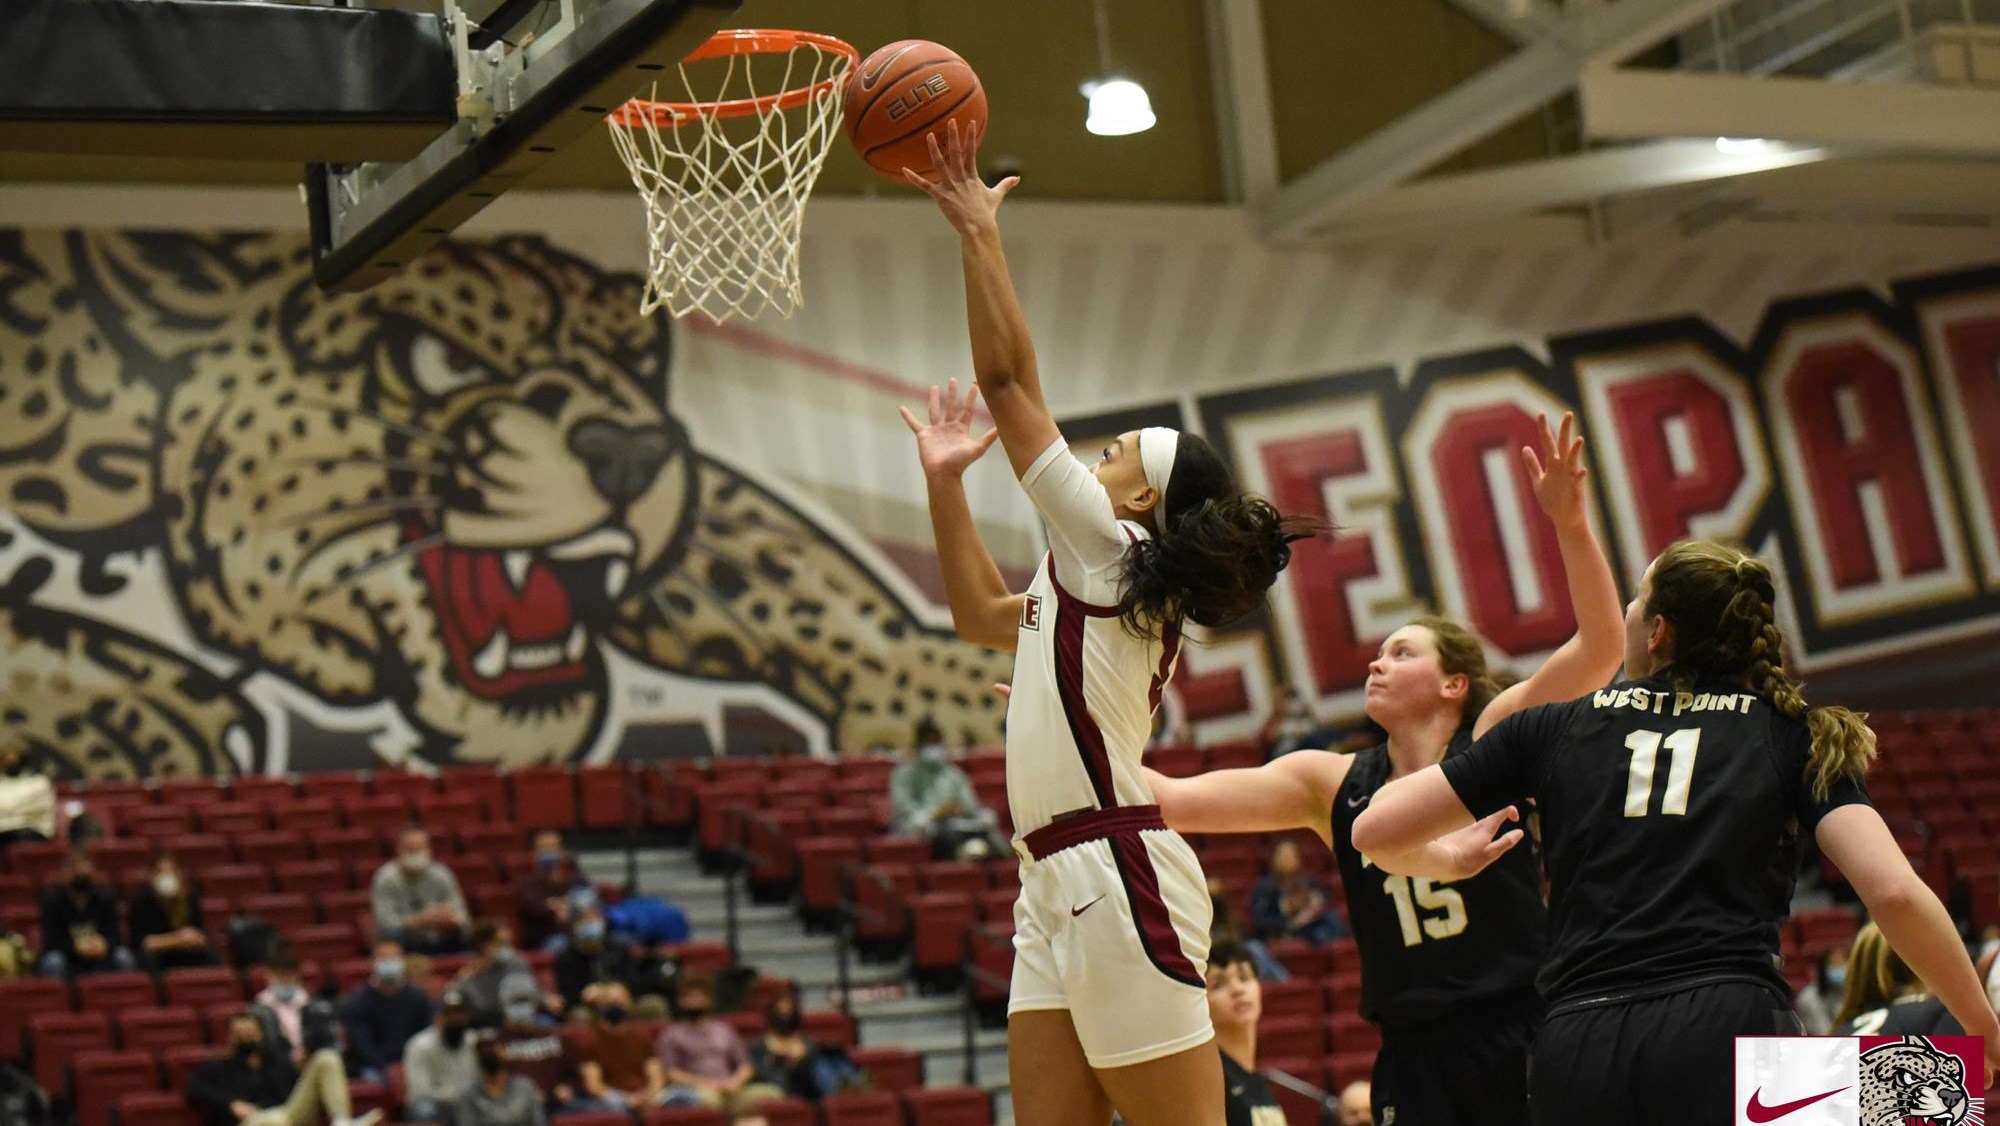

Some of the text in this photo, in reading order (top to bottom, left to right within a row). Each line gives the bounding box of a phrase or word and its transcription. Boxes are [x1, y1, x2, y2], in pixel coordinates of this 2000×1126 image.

[887, 72, 951, 121] ELITE
[1075, 290, 2000, 738] EOPA
[1593, 687, 1757, 716] WEST POINT
[1624, 728, 1701, 817] 11
[1383, 875, 1468, 947] 15
